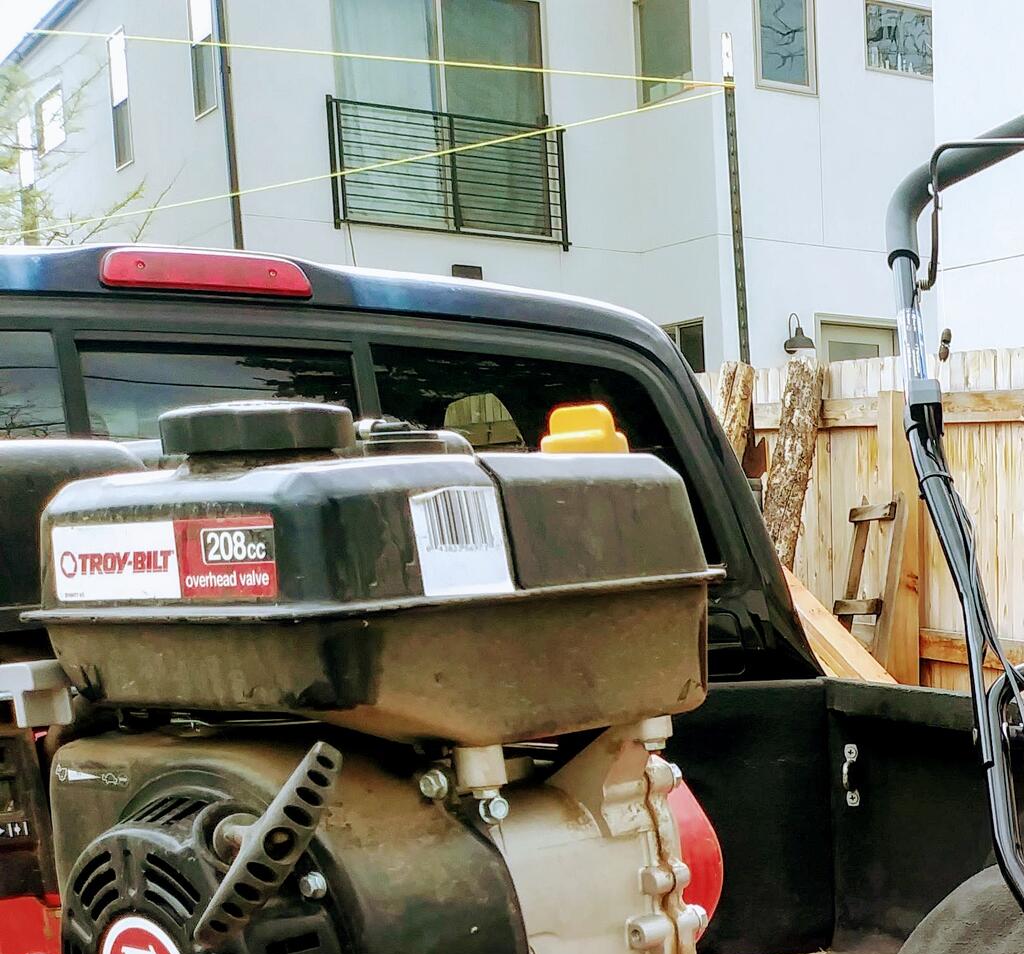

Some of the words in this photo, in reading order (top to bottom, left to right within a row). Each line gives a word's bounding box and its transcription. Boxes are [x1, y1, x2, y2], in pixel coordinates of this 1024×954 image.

[206, 530, 267, 561] 208cc
[78, 550, 173, 576] TROY-BILT
[185, 571, 237, 588] overhead
[239, 570, 270, 587] valve
